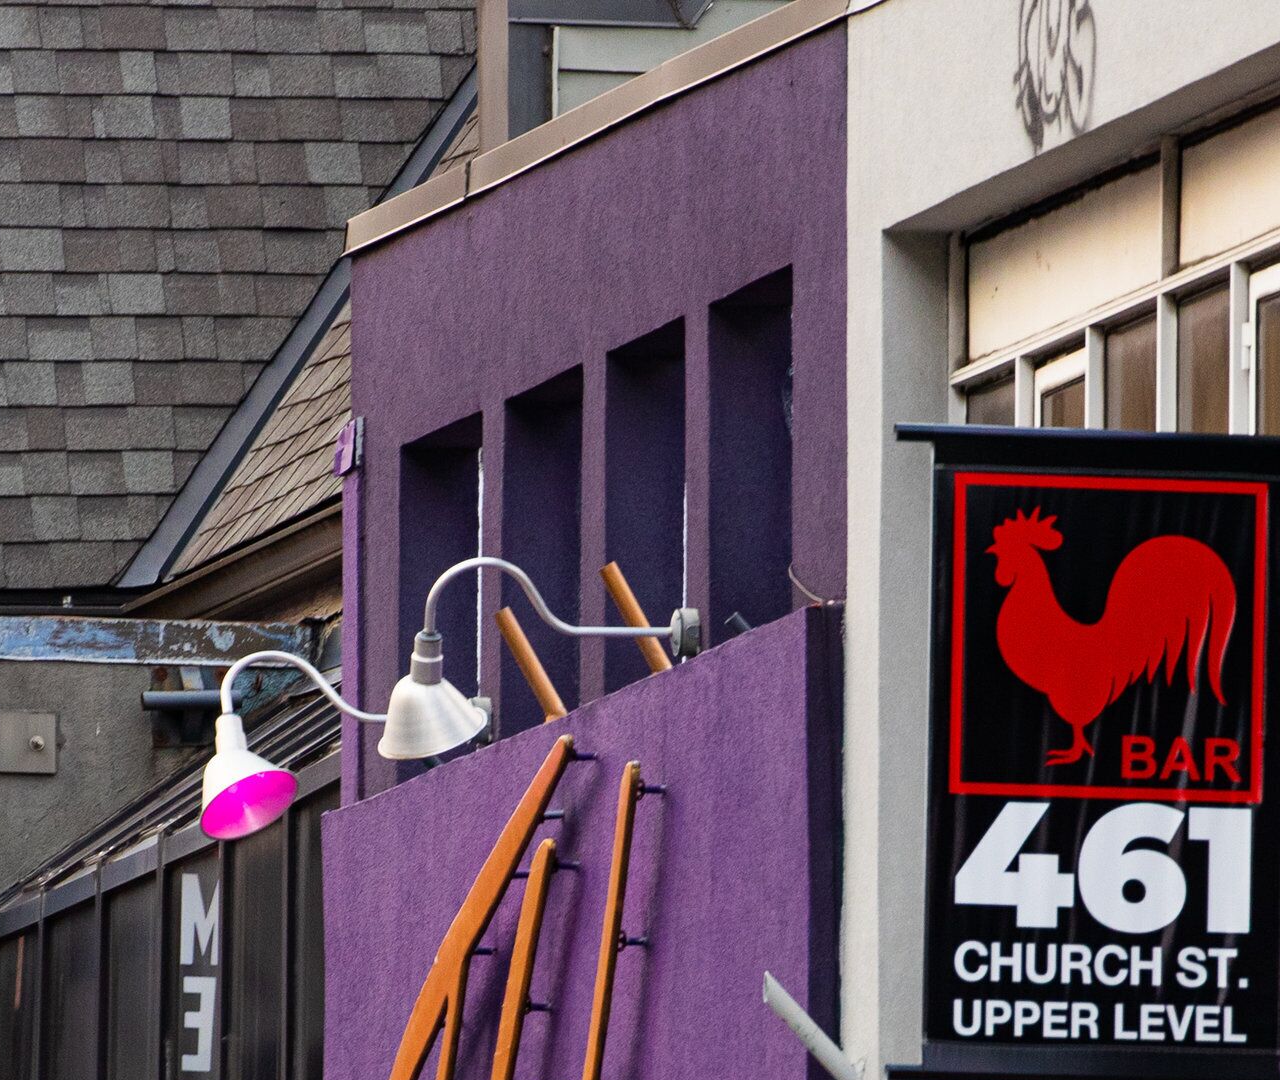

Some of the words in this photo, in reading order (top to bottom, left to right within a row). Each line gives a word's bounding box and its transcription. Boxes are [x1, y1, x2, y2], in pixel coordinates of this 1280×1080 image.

[1121, 735, 1242, 784] BAR
[954, 801, 1253, 935] 461
[953, 940, 1162, 987] CHURCH
[1176, 947, 1249, 989] ST.
[952, 998, 1099, 1040] UPPER
[1113, 1003, 1248, 1044] LEVEL
